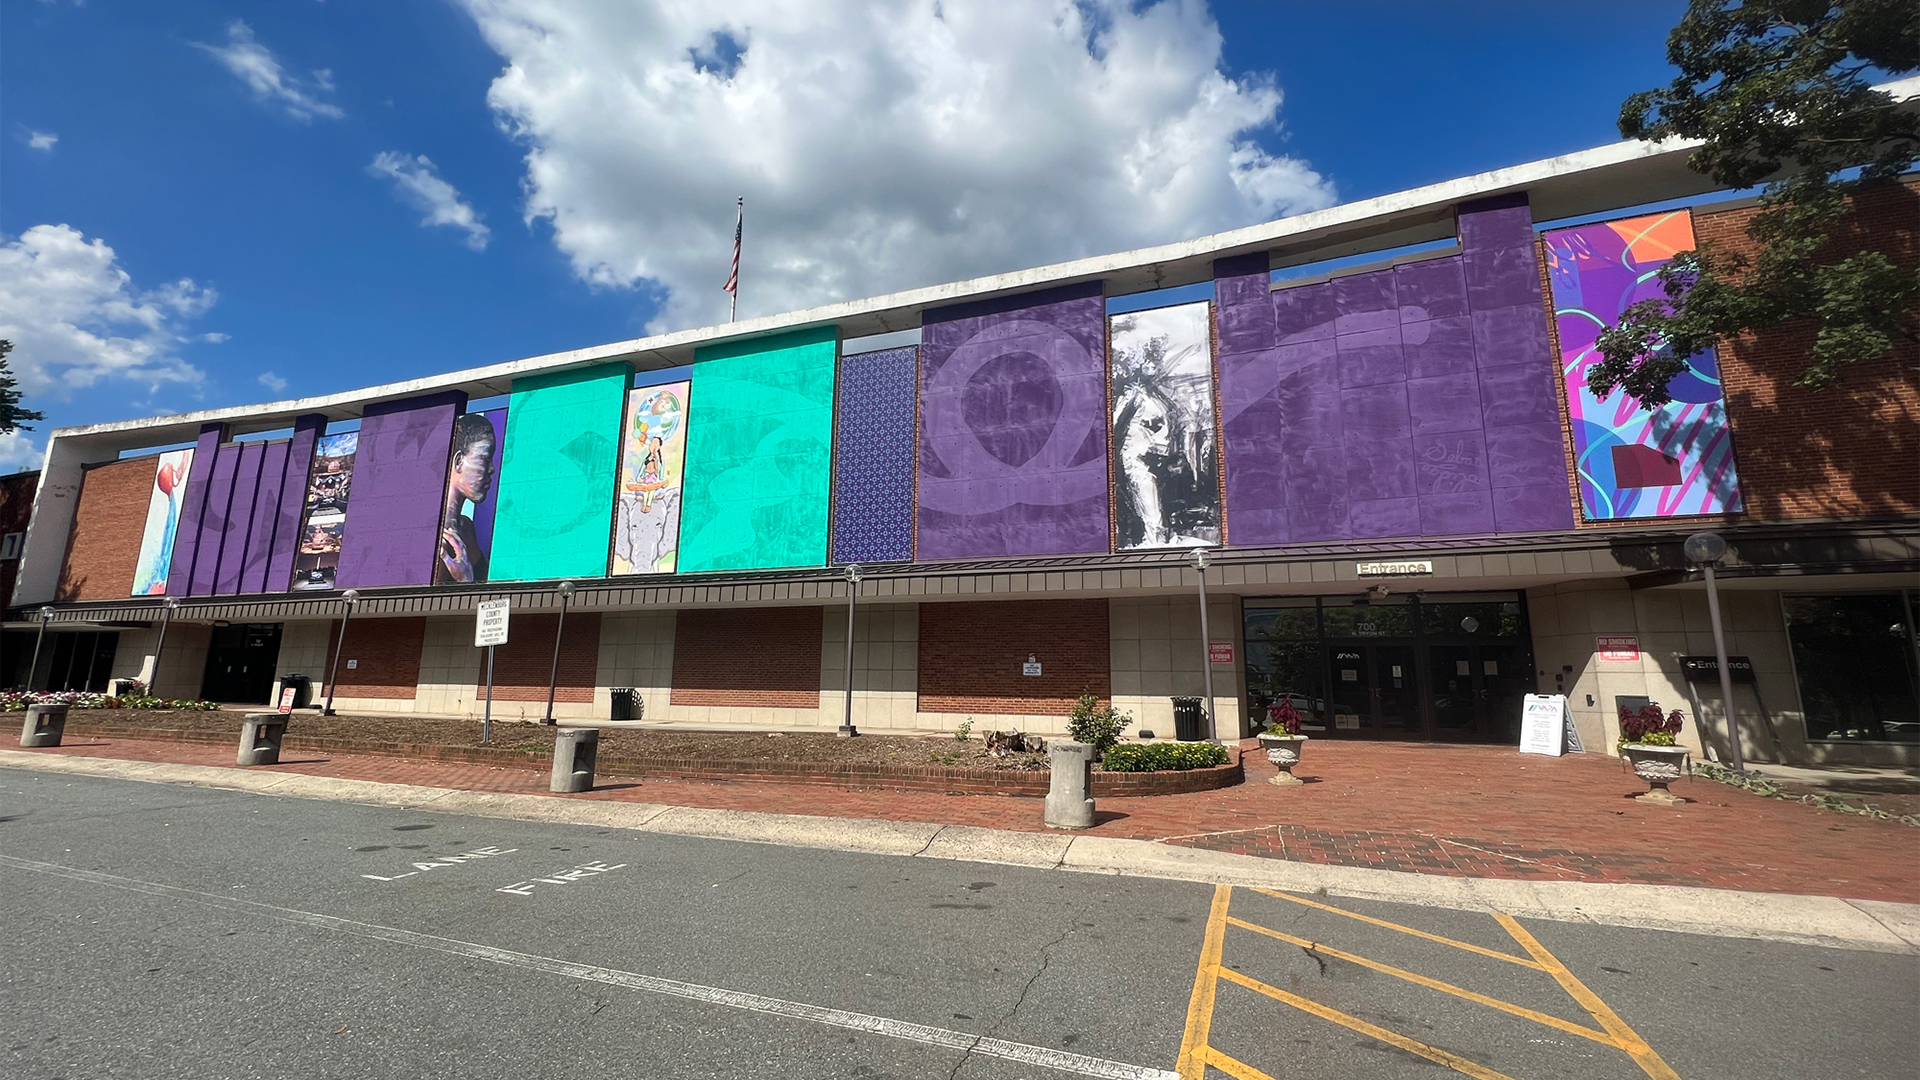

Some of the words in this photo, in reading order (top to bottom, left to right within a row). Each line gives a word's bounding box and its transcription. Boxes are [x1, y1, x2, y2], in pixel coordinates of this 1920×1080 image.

[1360, 563, 1427, 574] Entrance
[486, 610, 501, 618] COUNTY
[483, 618, 502, 626] PROPERTY
[1357, 622, 1376, 631] 700
[1696, 660, 1750, 669] Entnce
[360, 845, 519, 881] LANE
[495, 860, 627, 896] FIRE
